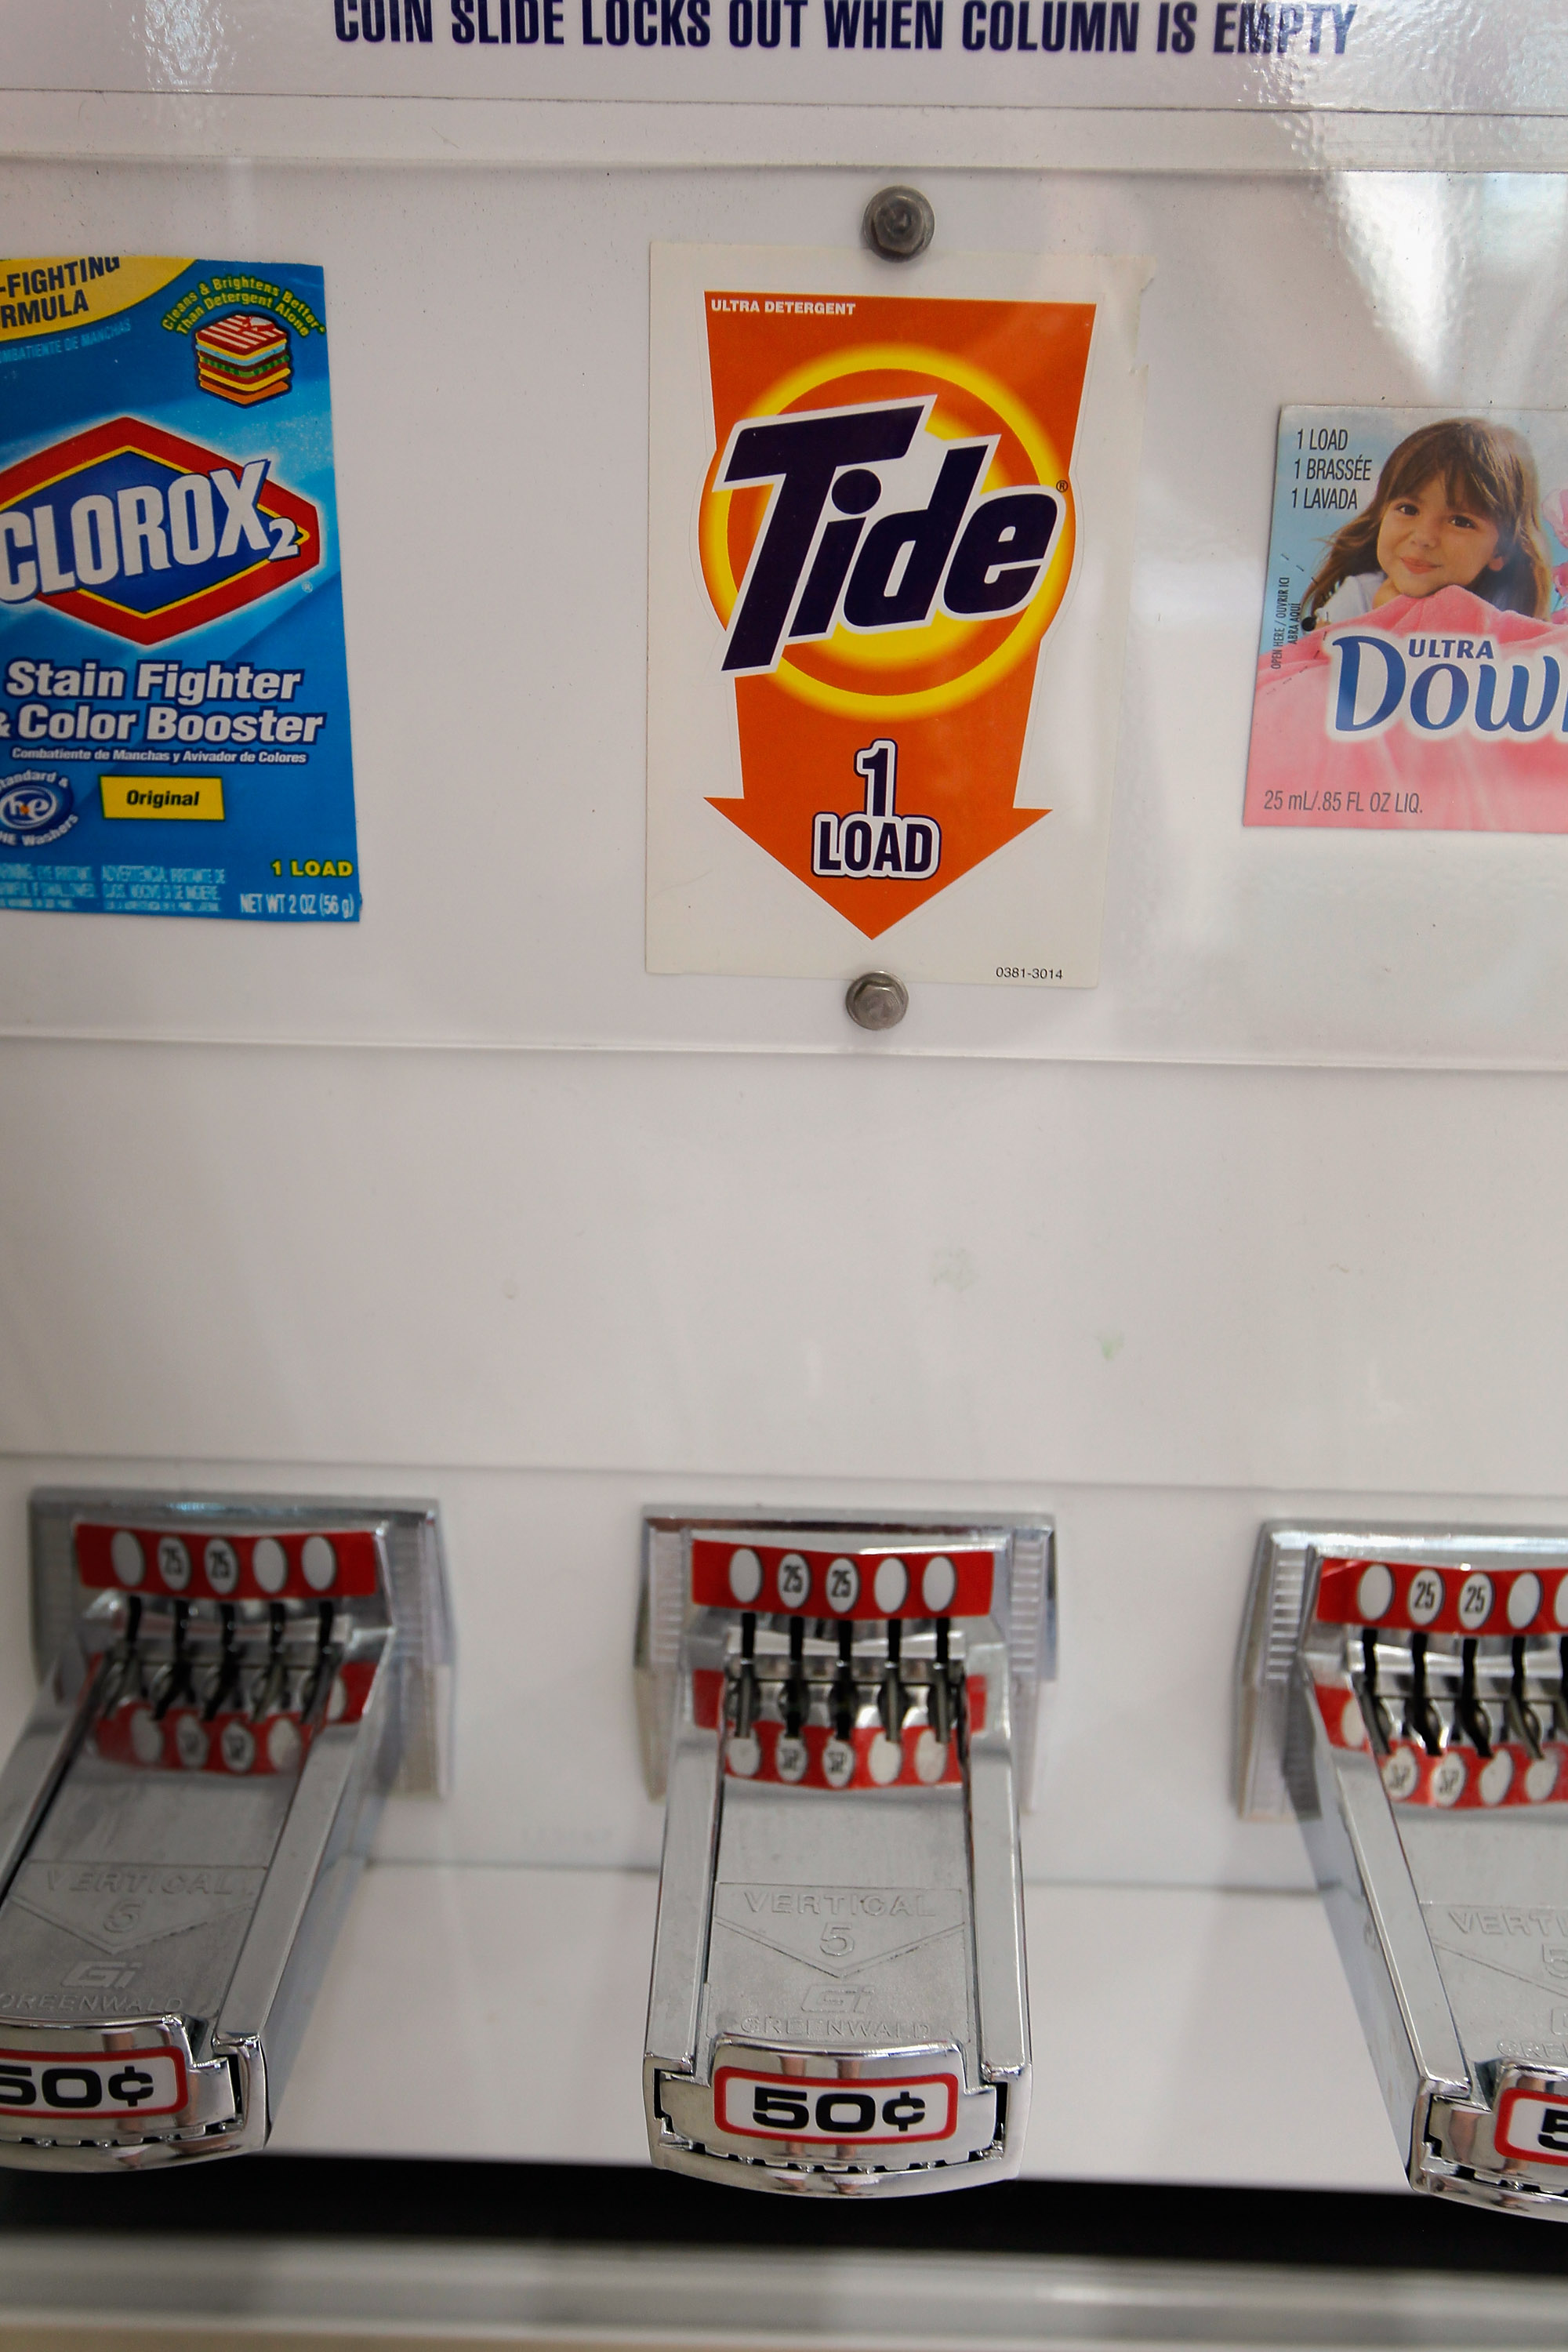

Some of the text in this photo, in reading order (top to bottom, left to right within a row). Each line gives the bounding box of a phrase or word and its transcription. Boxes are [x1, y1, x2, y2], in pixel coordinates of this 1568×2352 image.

[334, 0, 1358, 55] COIN SLIDE LOCKS OUT WHEN COLUMN IS EMPTY
[162, 291, 198, 331] Cleans
[198, 282, 211, 296] &
[212, 275, 280, 297] Brightens
[176, 292, 310, 337] Than Detergent Alone
[710, 299, 856, 315] ULTRA DETERGENT
[1298, 428, 1348, 451] 1 LOAD
[1294, 454, 1372, 481] 1 BRASSÉE
[1292, 487, 1358, 510] 1 LAVADA
[720, 405, 1058, 671] Tide
[1279, 577, 1290, 587] ICI
[1276, 590, 1288, 619] OUVRIR
[1273, 627, 1285, 647] HERE
[1287, 624, 1299, 644] ABRA
[1270, 649, 1283, 670] OPEN
[1409, 638, 1494, 660] ULTRA
[6, 660, 302, 706] Stain Fighter
[1332, 636, 1568, 732] Dow
[18, 703, 137, 740] Color
[147, 707, 323, 742] Booster
[12, 746, 307, 764] Combatiente de Manchas y Avivador de Colores
[859, 744, 893, 817] 1
[126, 789, 200, 808] Original
[1264, 789, 1283, 811] 25
[1346, 791, 1364, 811] FL
[1370, 792, 1391, 812] OZ
[1395, 793, 1423, 814] LIQ.
[815, 817, 937, 876] LOAD
[272, 860, 354, 877] 1 LOAD
[240, 893, 263, 913] NET
[266, 893, 285, 914] WT
[289, 894, 297, 914] 2
[299, 894, 317, 915] OZ
[319, 892, 339, 917] (56
[995, 967, 1064, 980] 0381-3014
[782, 1565, 852, 1598] 25 25
[1414, 1581, 1486, 1614] 25 25
[47, 1869, 234, 1896] VERTICAL
[744, 1889, 937, 1917] VERTICAL
[819, 1922, 855, 1957] 5
[740, 2016, 931, 2039] GREENWALD
[752, 2085, 926, 2133] 50¢
